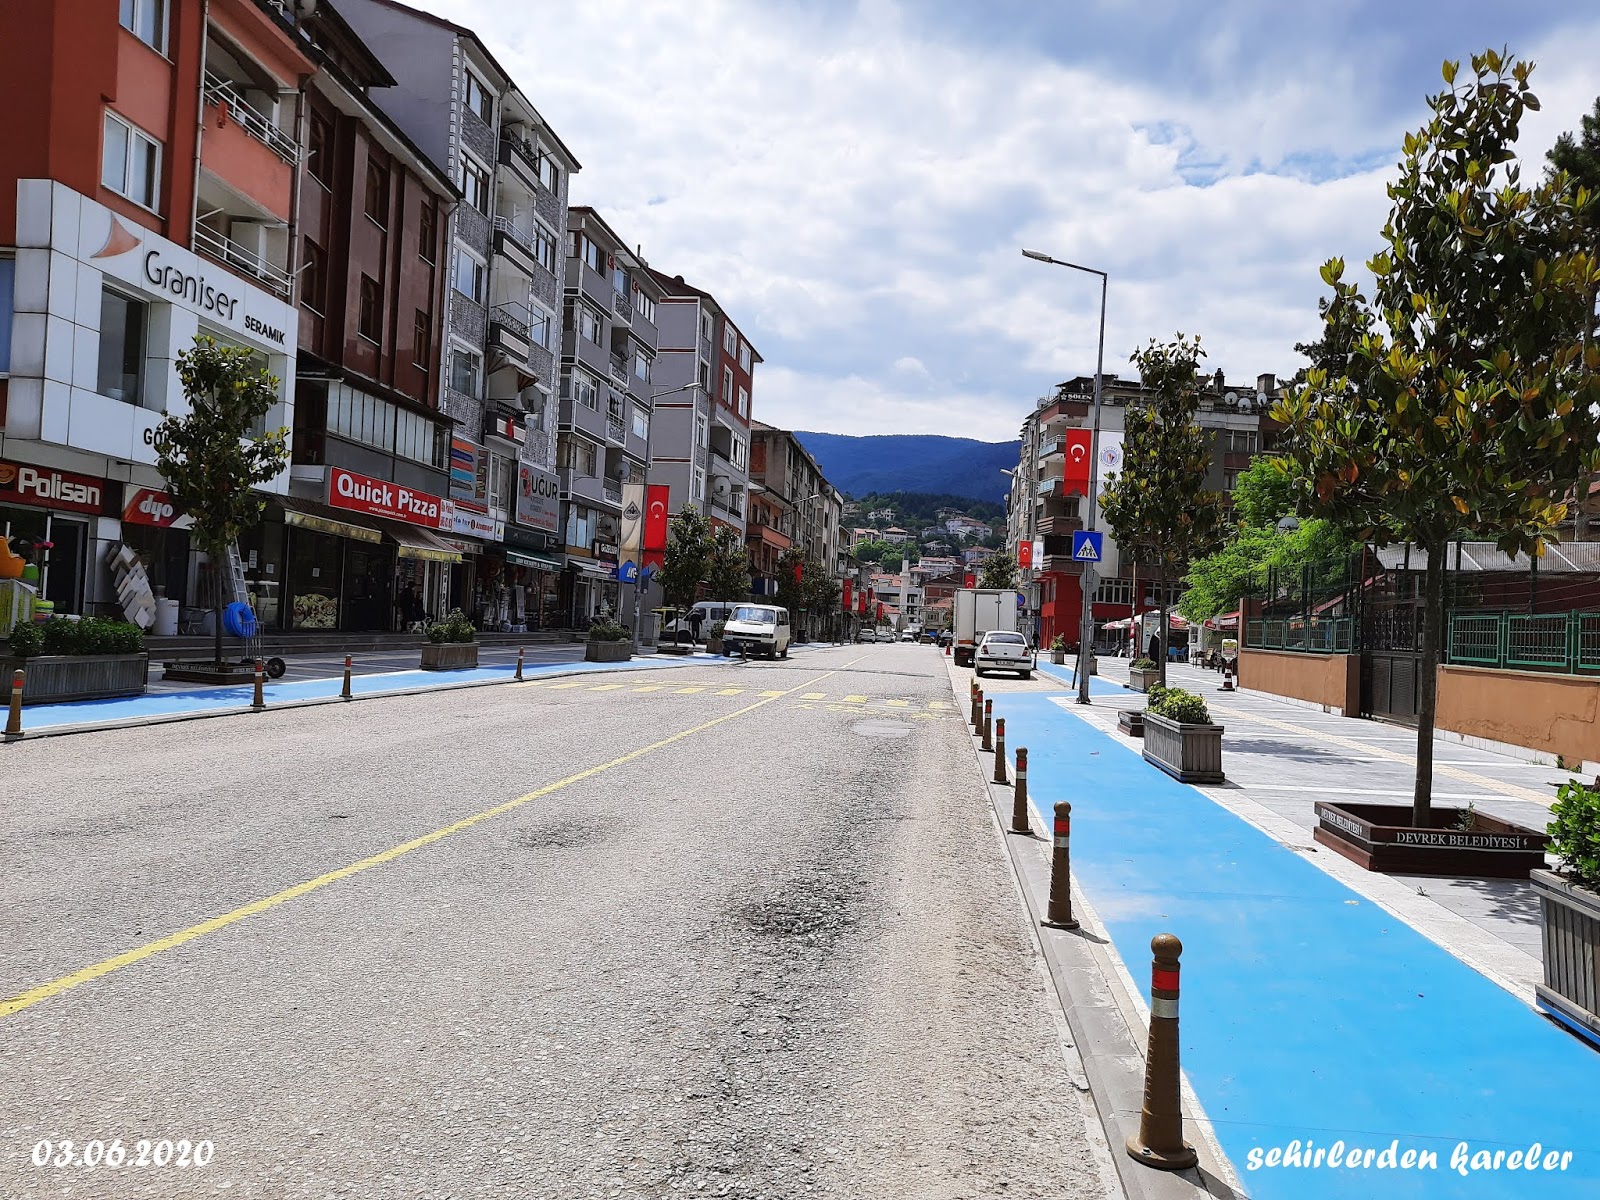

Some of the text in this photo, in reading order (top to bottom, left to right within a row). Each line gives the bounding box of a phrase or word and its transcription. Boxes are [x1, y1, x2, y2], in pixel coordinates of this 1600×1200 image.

[144, 250, 238, 320] Graniser
[18, 467, 100, 506] Polisan
[337, 473, 392, 507] Quick
[397, 489, 437, 518] Pizza
[531, 474, 558, 501] UĞUR
[138, 494, 174, 522] dyo
[1397, 832, 1520, 848] DEVREK BELEDİYESİ
